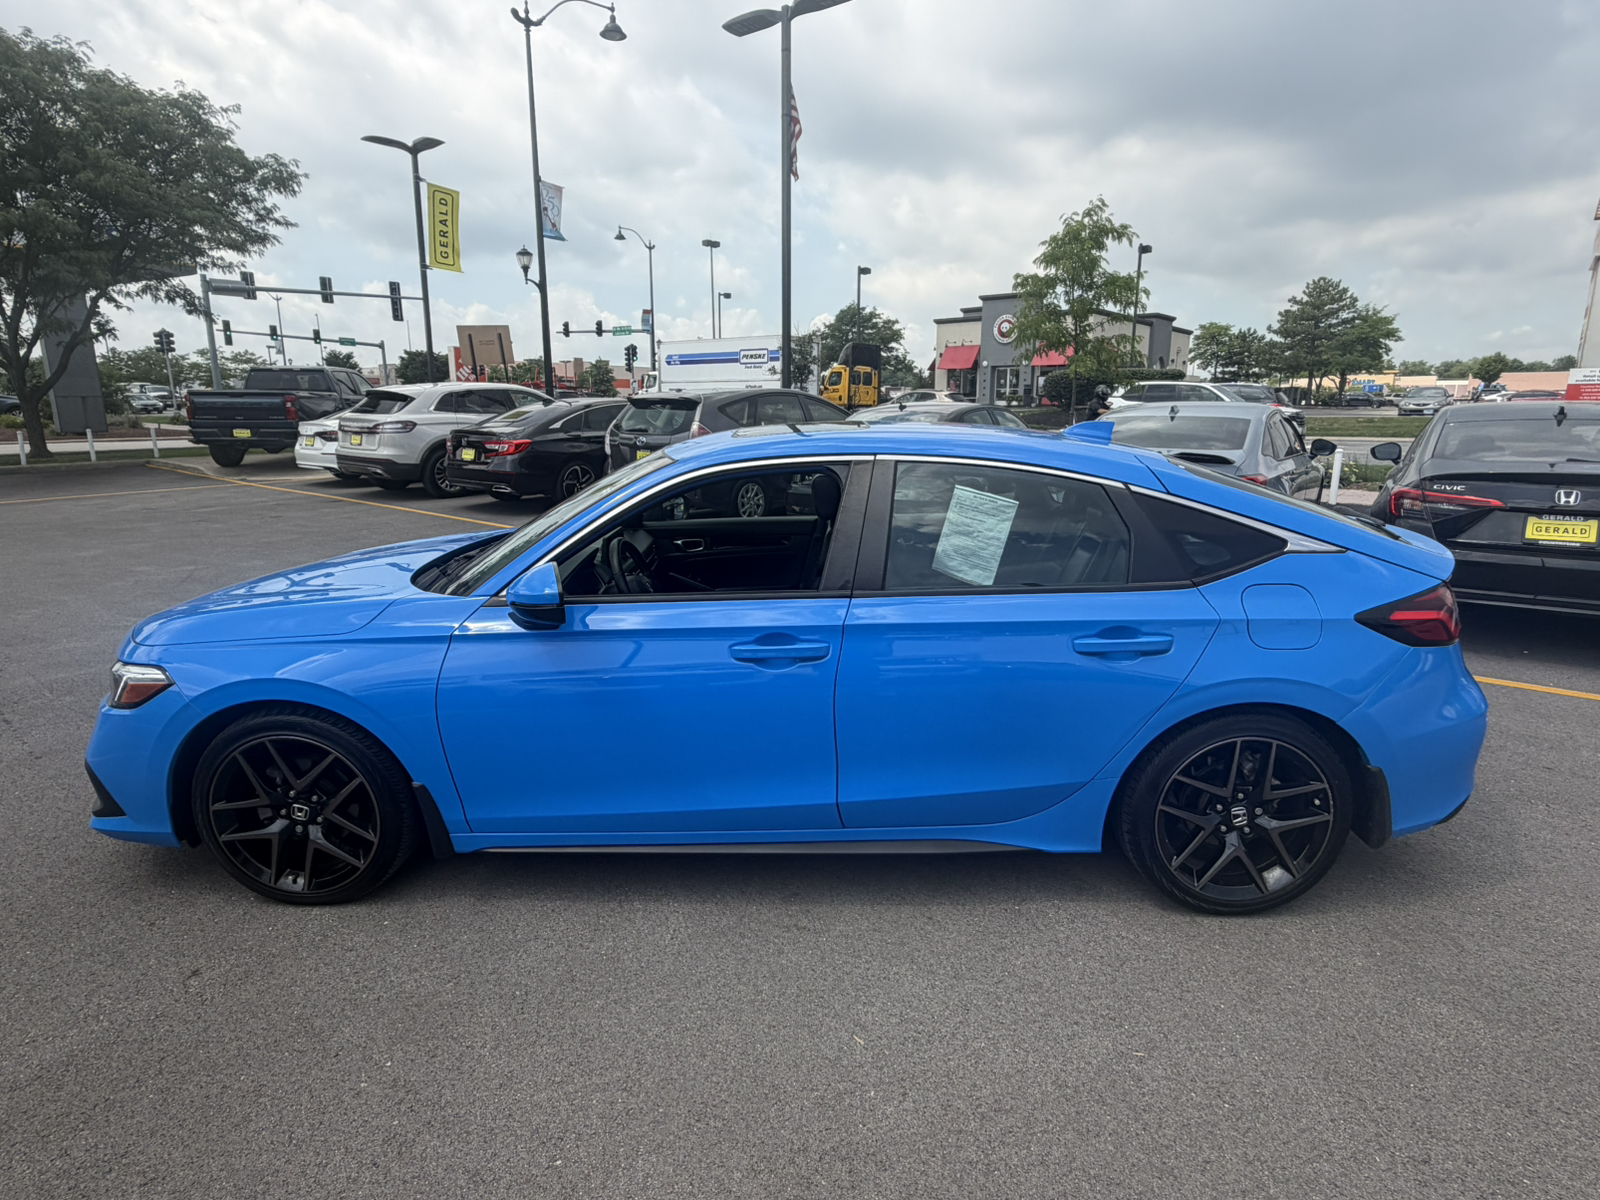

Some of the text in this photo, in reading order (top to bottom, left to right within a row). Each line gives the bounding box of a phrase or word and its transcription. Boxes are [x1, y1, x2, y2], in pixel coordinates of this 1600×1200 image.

[438, 197, 449, 260] GERALD
[1433, 483, 1467, 492] CIVIC
[1542, 513, 1584, 522] GERALD
[1535, 525, 1588, 535] GERALD
